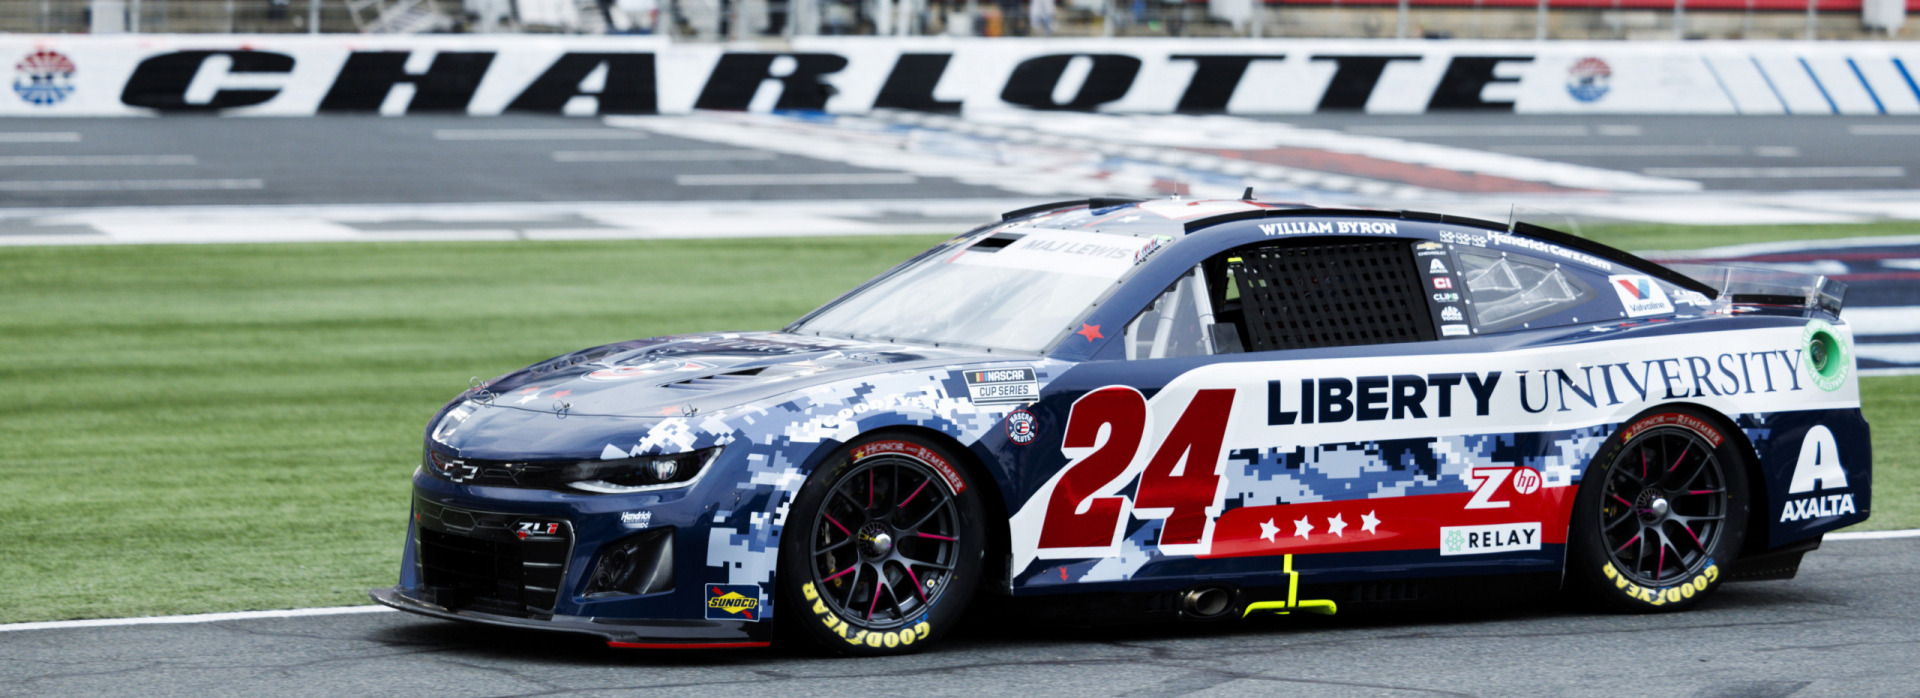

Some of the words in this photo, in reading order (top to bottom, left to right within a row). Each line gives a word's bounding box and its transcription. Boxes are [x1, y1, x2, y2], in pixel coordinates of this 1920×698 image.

[120, 50, 1535, 116] CHARLOTTE
[1258, 222, 1332, 236] WILLIAM
[1337, 222, 1397, 235] BYRON
[1021, 240, 1063, 252] MAJ
[1058, 244, 1132, 259] LEWIS
[1629, 301, 1666, 313] Valvoline
[988, 370, 1025, 381] NASCAR
[980, 387, 997, 396] CUP
[999, 385, 1029, 395] SERIES
[1267, 371, 1501, 425] LIBERTY
[1515, 348, 1803, 413] UNIVERSITY
[1009, 412, 1033, 424] NASCAR
[1009, 431, 1035, 443] SALUTES
[1632, 415, 1664, 433] HONOR
[1676, 414, 1721, 445] REMEMBER
[865, 442, 904, 455] HONOR
[917, 447, 963, 491] REMEMBER
[1037, 386, 1237, 552] 24
[1516, 469, 1537, 494] hp
[621, 511, 652, 523] Hendrick
[1780, 494, 1856, 522] AXALTA
[517, 522, 559, 536] ZL1
[1469, 529, 1536, 548] RELAY
[1603, 560, 1719, 606] GOODYEAR
[710, 598, 756, 608] SUNOCO
[802, 580, 931, 648] GOODYEAR
